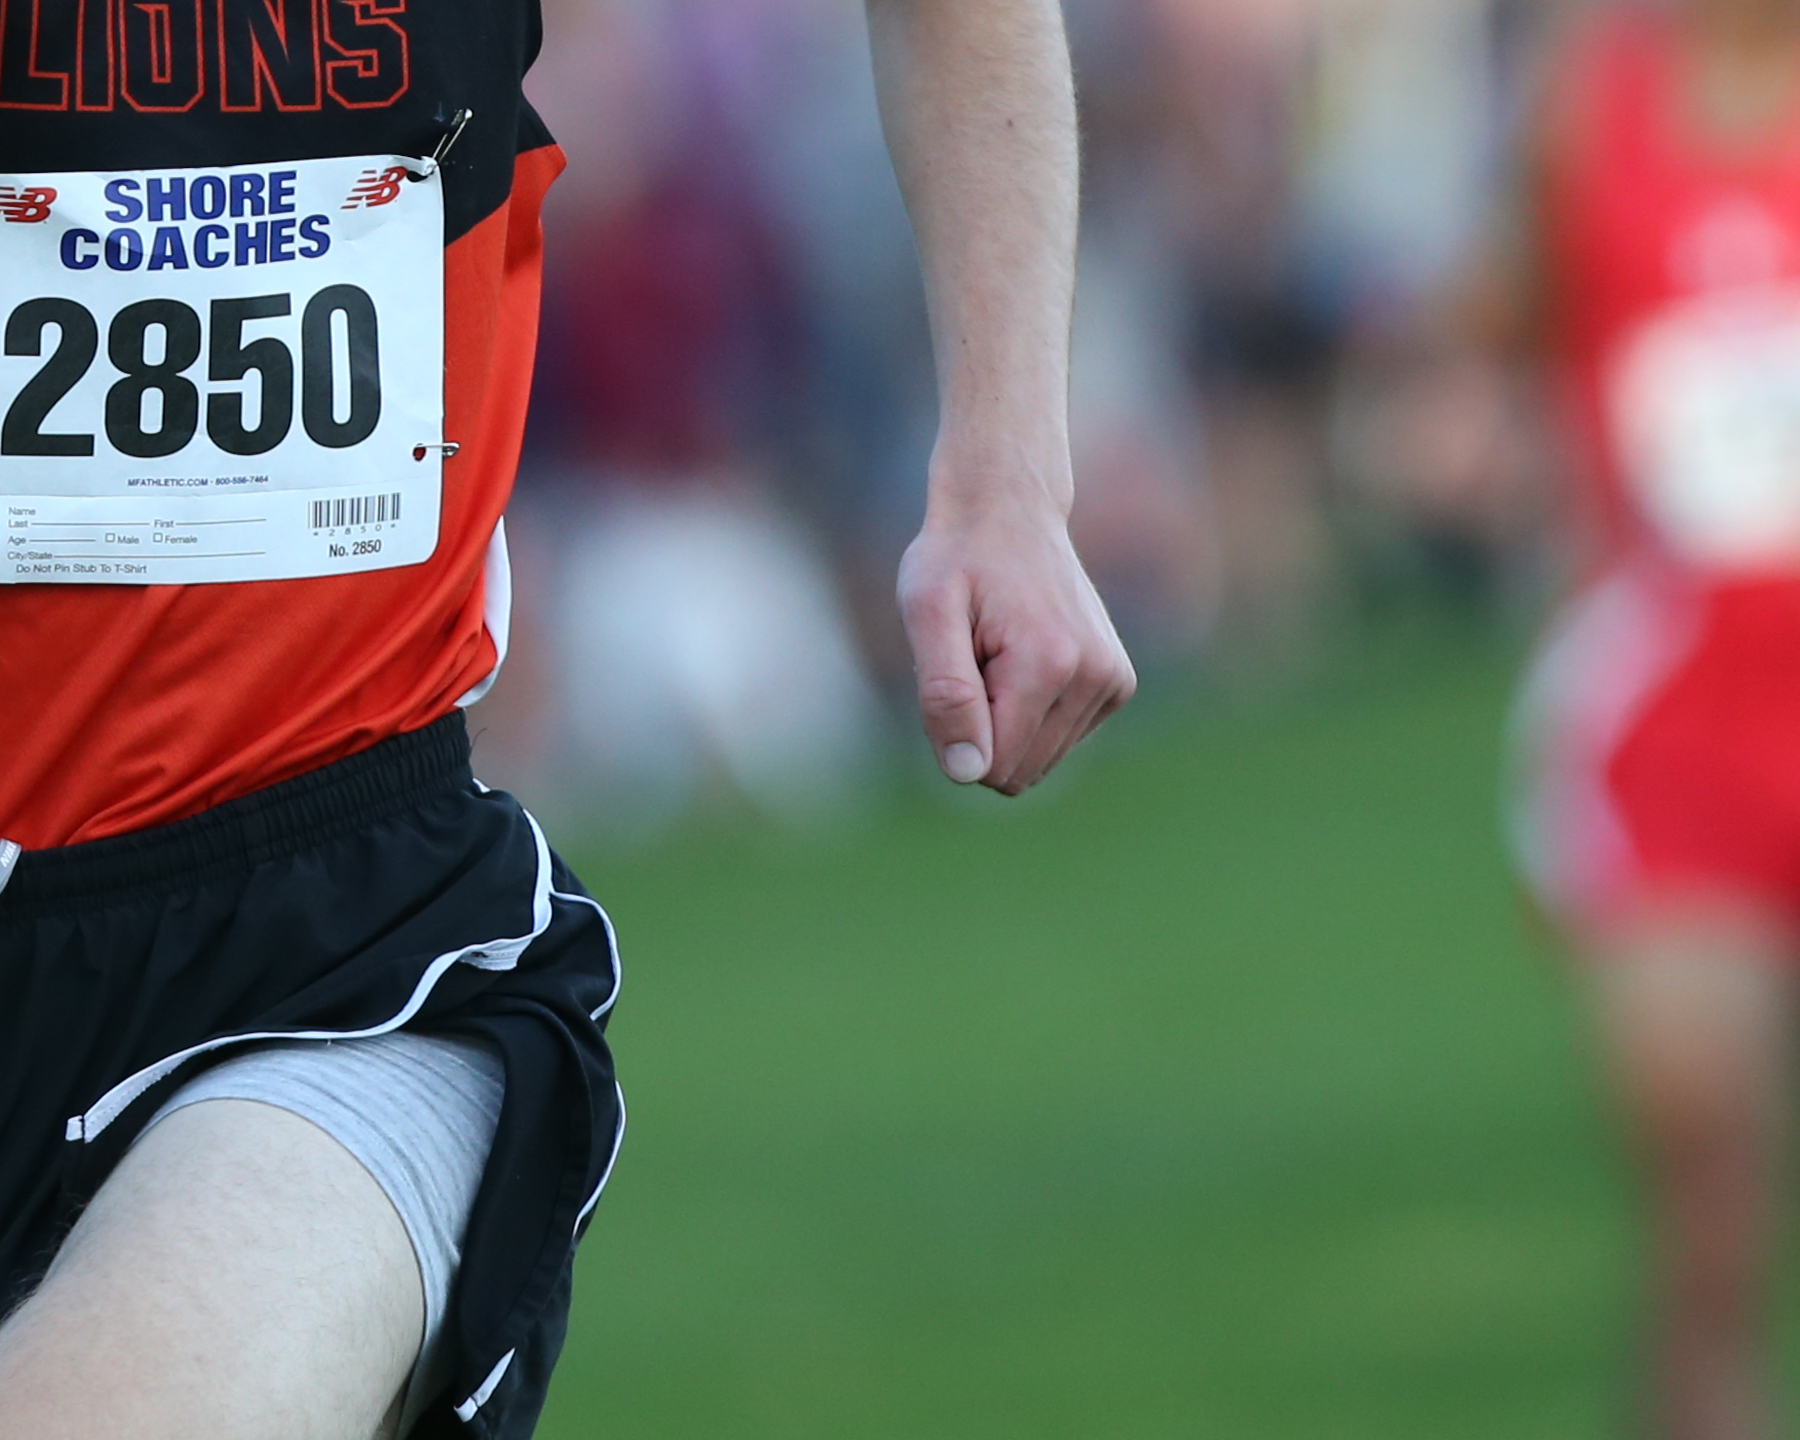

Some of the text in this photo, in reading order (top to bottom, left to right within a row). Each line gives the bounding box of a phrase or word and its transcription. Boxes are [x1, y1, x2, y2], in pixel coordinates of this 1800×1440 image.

[104, 170, 298, 223] SHORE
[59, 214, 332, 271] COACHES
[0, 283, 382, 458] 2850
[127, 478, 209, 487] MFATHLETIC.COM
[8, 507, 36, 516] Name
[8, 519, 175, 528] Last First
[7, 534, 198, 546] Age Male Female
[328, 539, 382, 558] No. 2850
[7, 551, 53, 561] City/State
[16, 563, 147, 573] Do Not Pin Stub To T-Shirt
